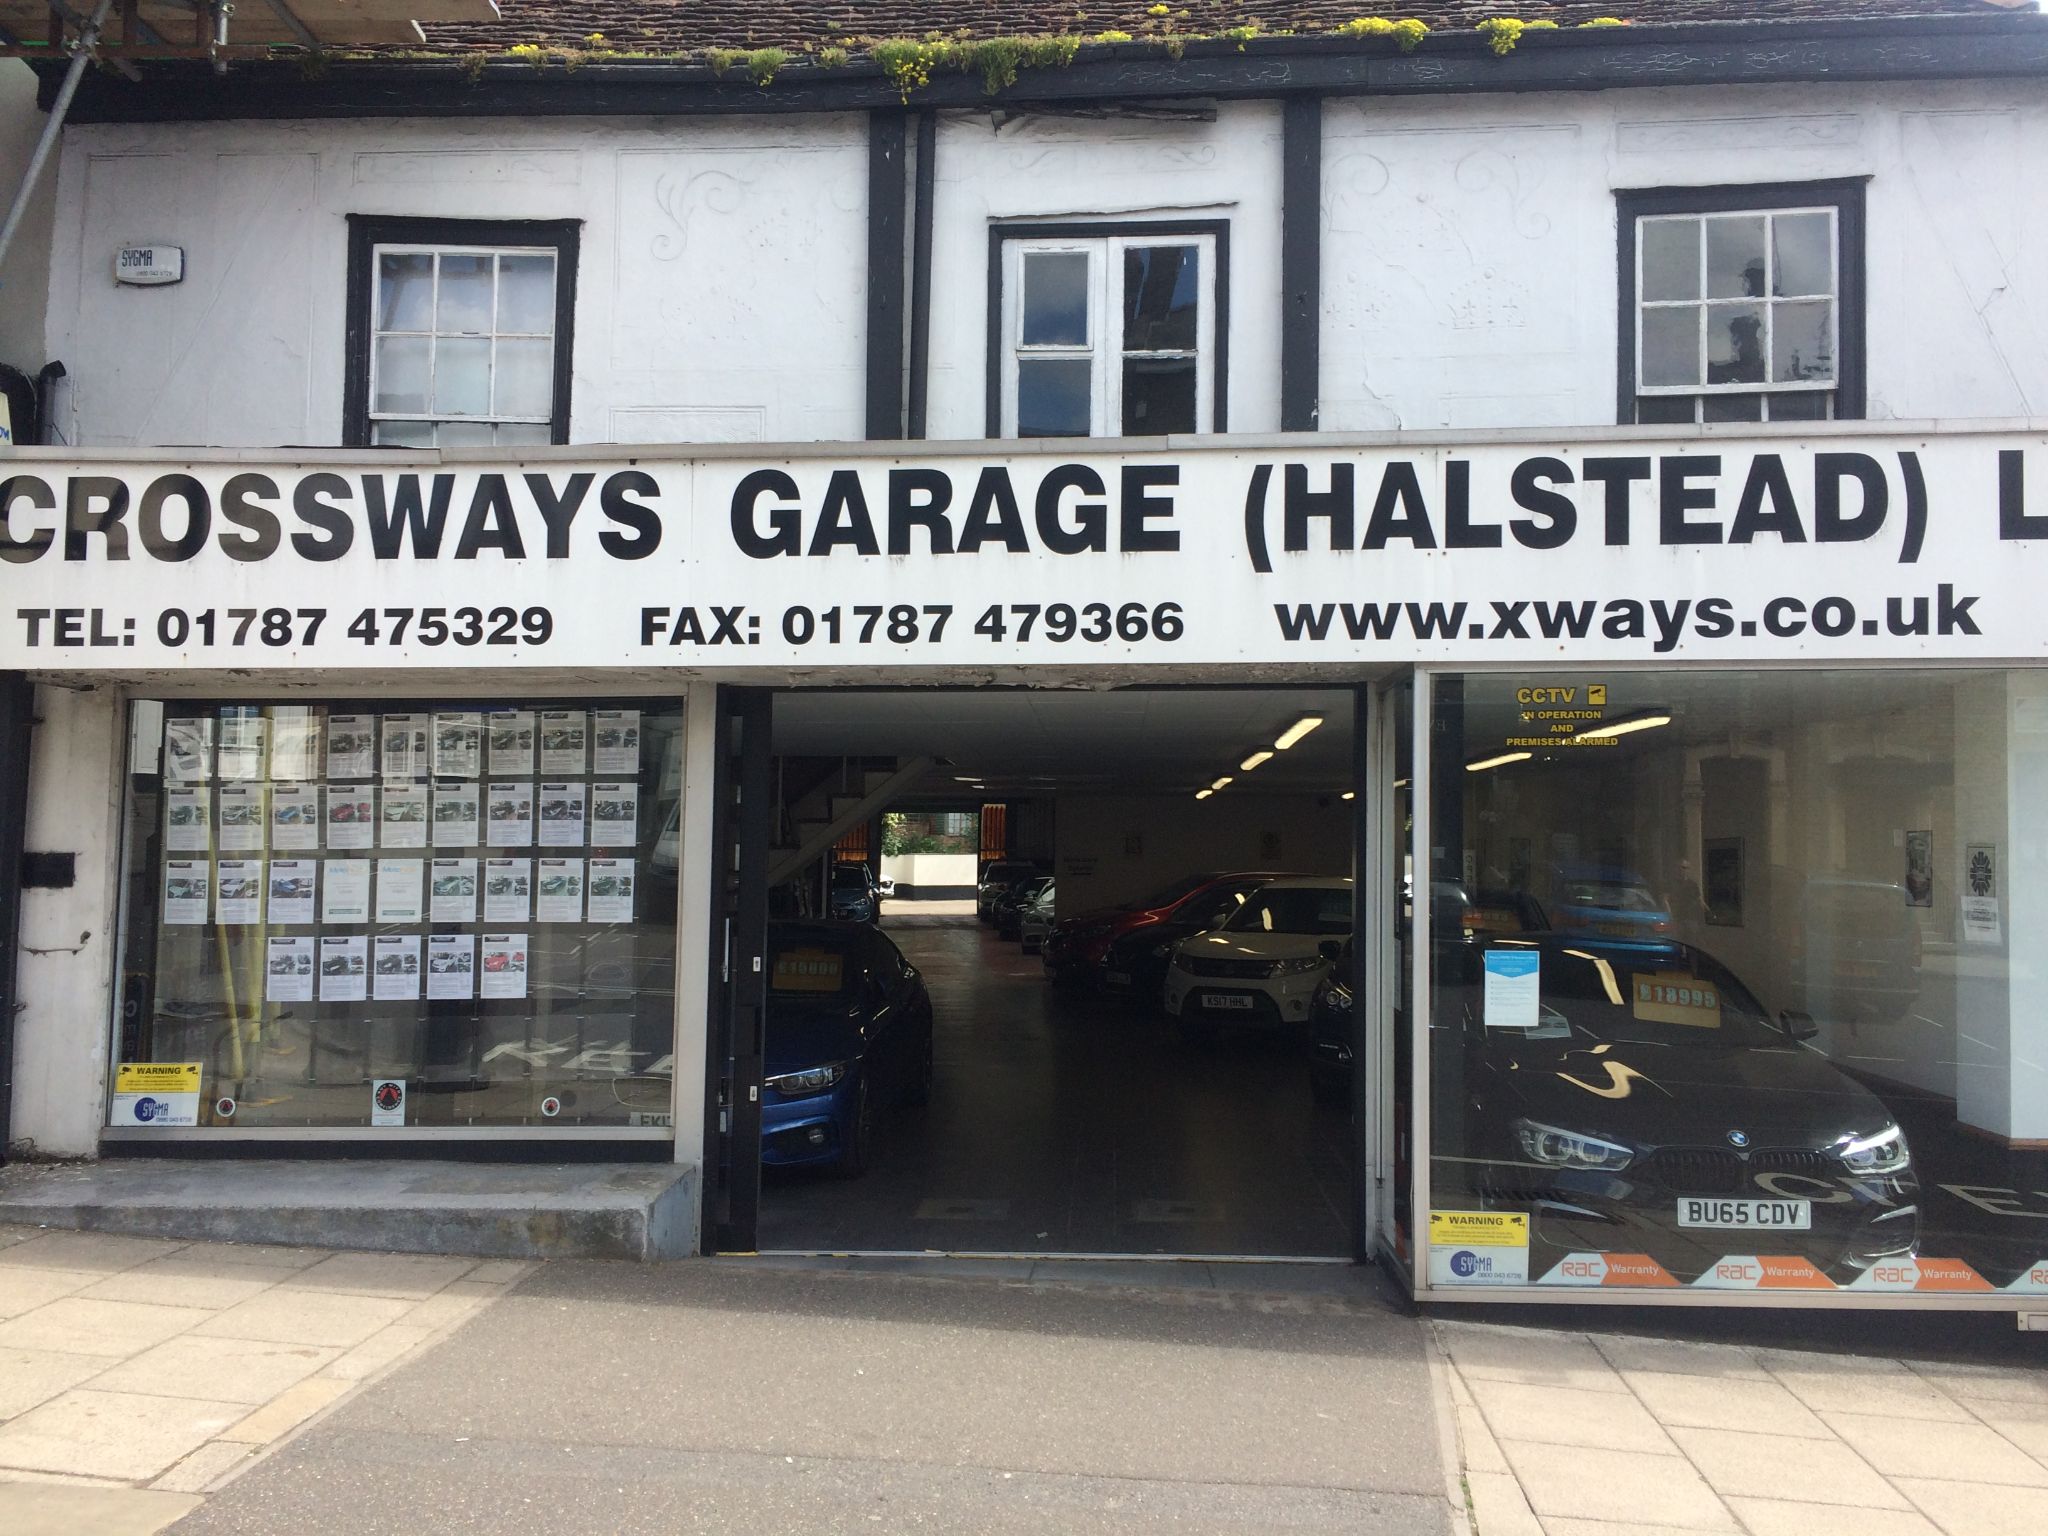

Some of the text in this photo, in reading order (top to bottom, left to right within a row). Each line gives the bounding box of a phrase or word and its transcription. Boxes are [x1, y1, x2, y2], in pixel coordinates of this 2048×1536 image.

[121, 249, 153, 267] SYGMA
[0, 471, 663, 563] CROSSWAYS
[730, 463, 1181, 558] GARAGE
[1244, 450, 1929, 574] (HALSTEAD)
[641, 602, 1185, 646] FAX: 01787 479366
[1275, 583, 1983, 653] www.xways.co.uk
[17, 606, 554, 647] TEL: 01787 475329
[1517, 687, 1576, 704] CCTV
[1522, 710, 1602, 720] IN OPERATION
[1550, 724, 1574, 733] AND
[1506, 737, 1619, 746] PREMISES ALARMED
[136, 1066, 181, 1075] WARNING
[142, 1102, 169, 1117] SYGMA
[1448, 1215, 1504, 1226] WARNING
[1687, 1201, 1800, 1226] BU65 CDV
[1460, 1255, 1492, 1273] SYGMA
[1610, 1264, 1660, 1279] Warranty
[1766, 1266, 1815, 1280] Warranty
[1923, 1268, 1972, 1283] Warranty
